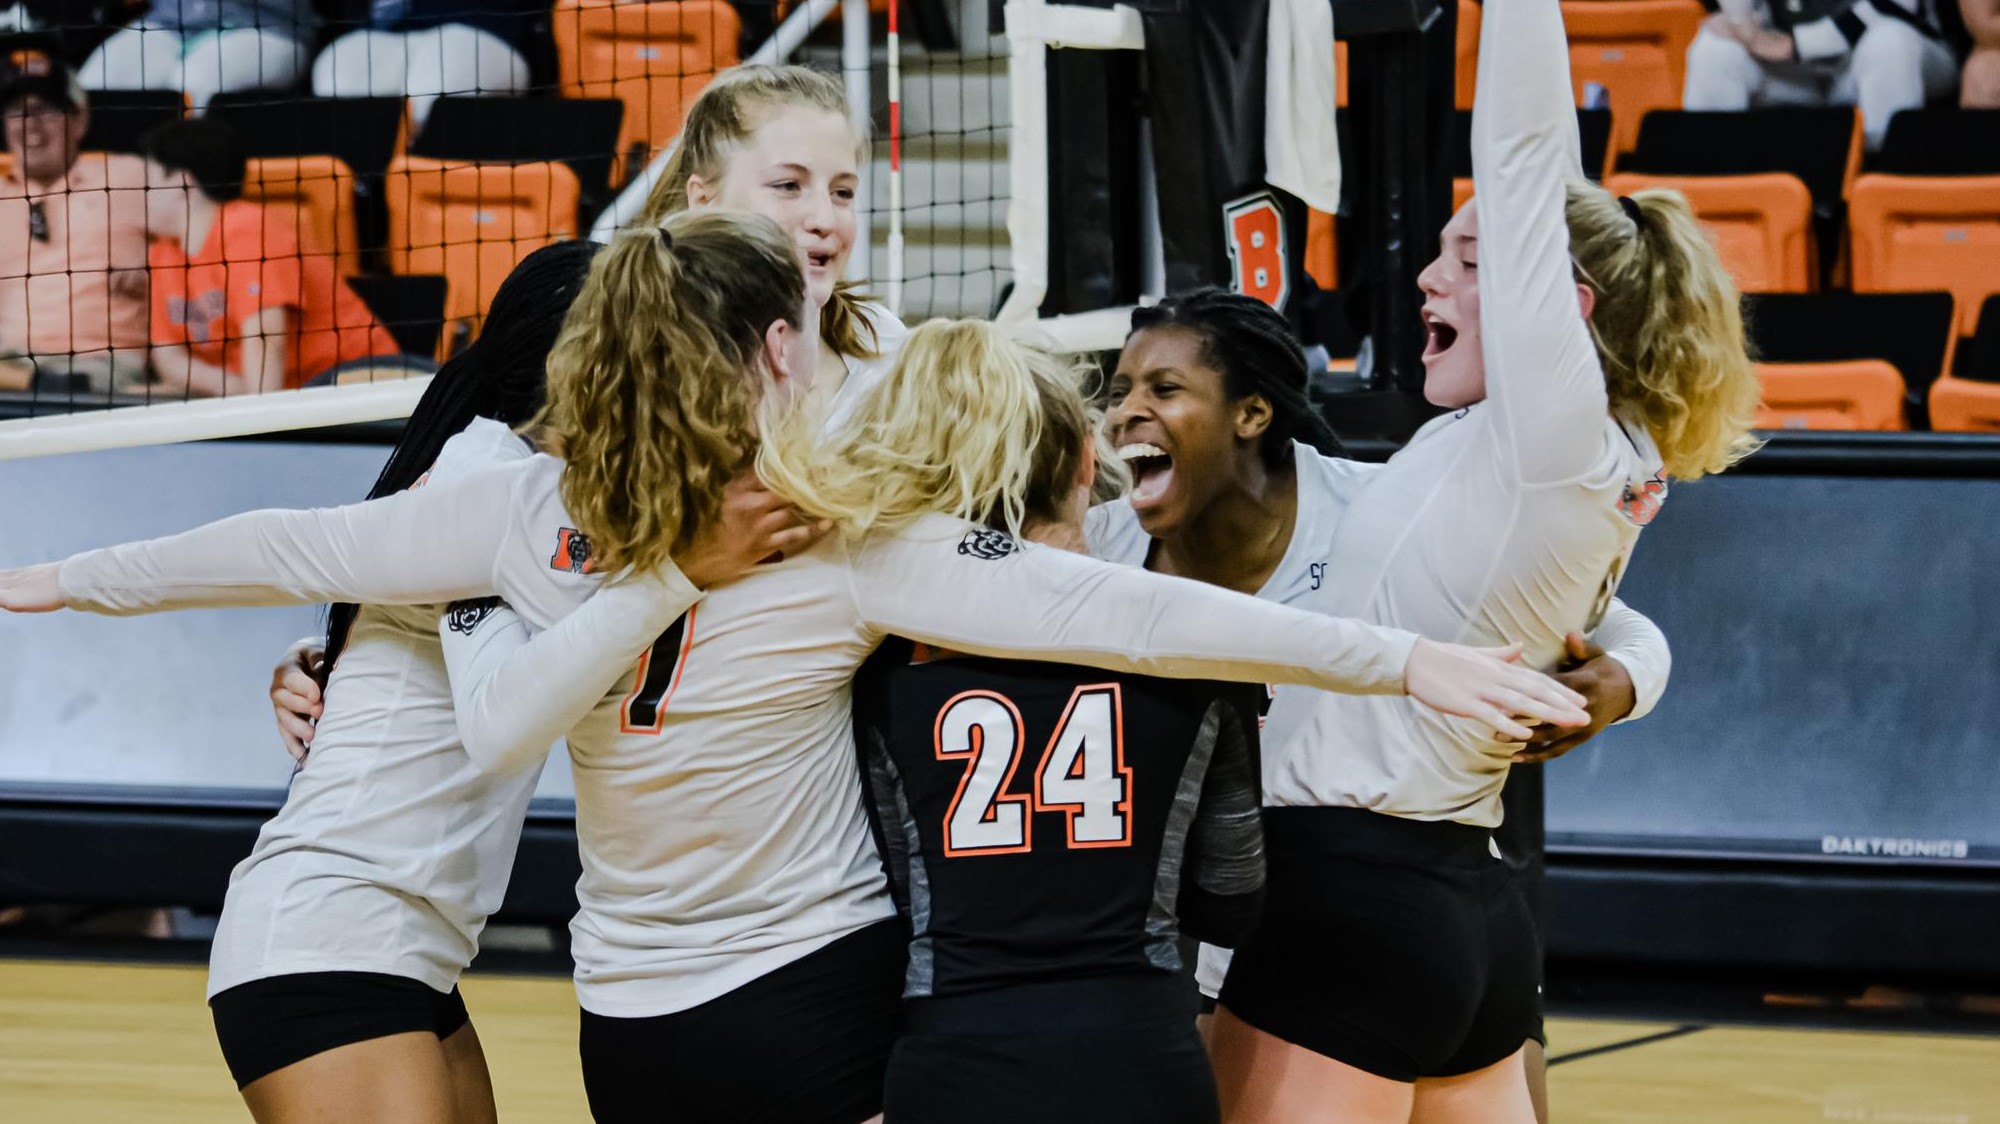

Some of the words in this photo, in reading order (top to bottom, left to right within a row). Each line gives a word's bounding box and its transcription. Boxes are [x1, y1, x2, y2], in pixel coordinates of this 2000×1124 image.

[1222, 190, 1291, 316] B
[934, 682, 1133, 858] 24
[1821, 835, 1968, 858] DAKTRONICS
